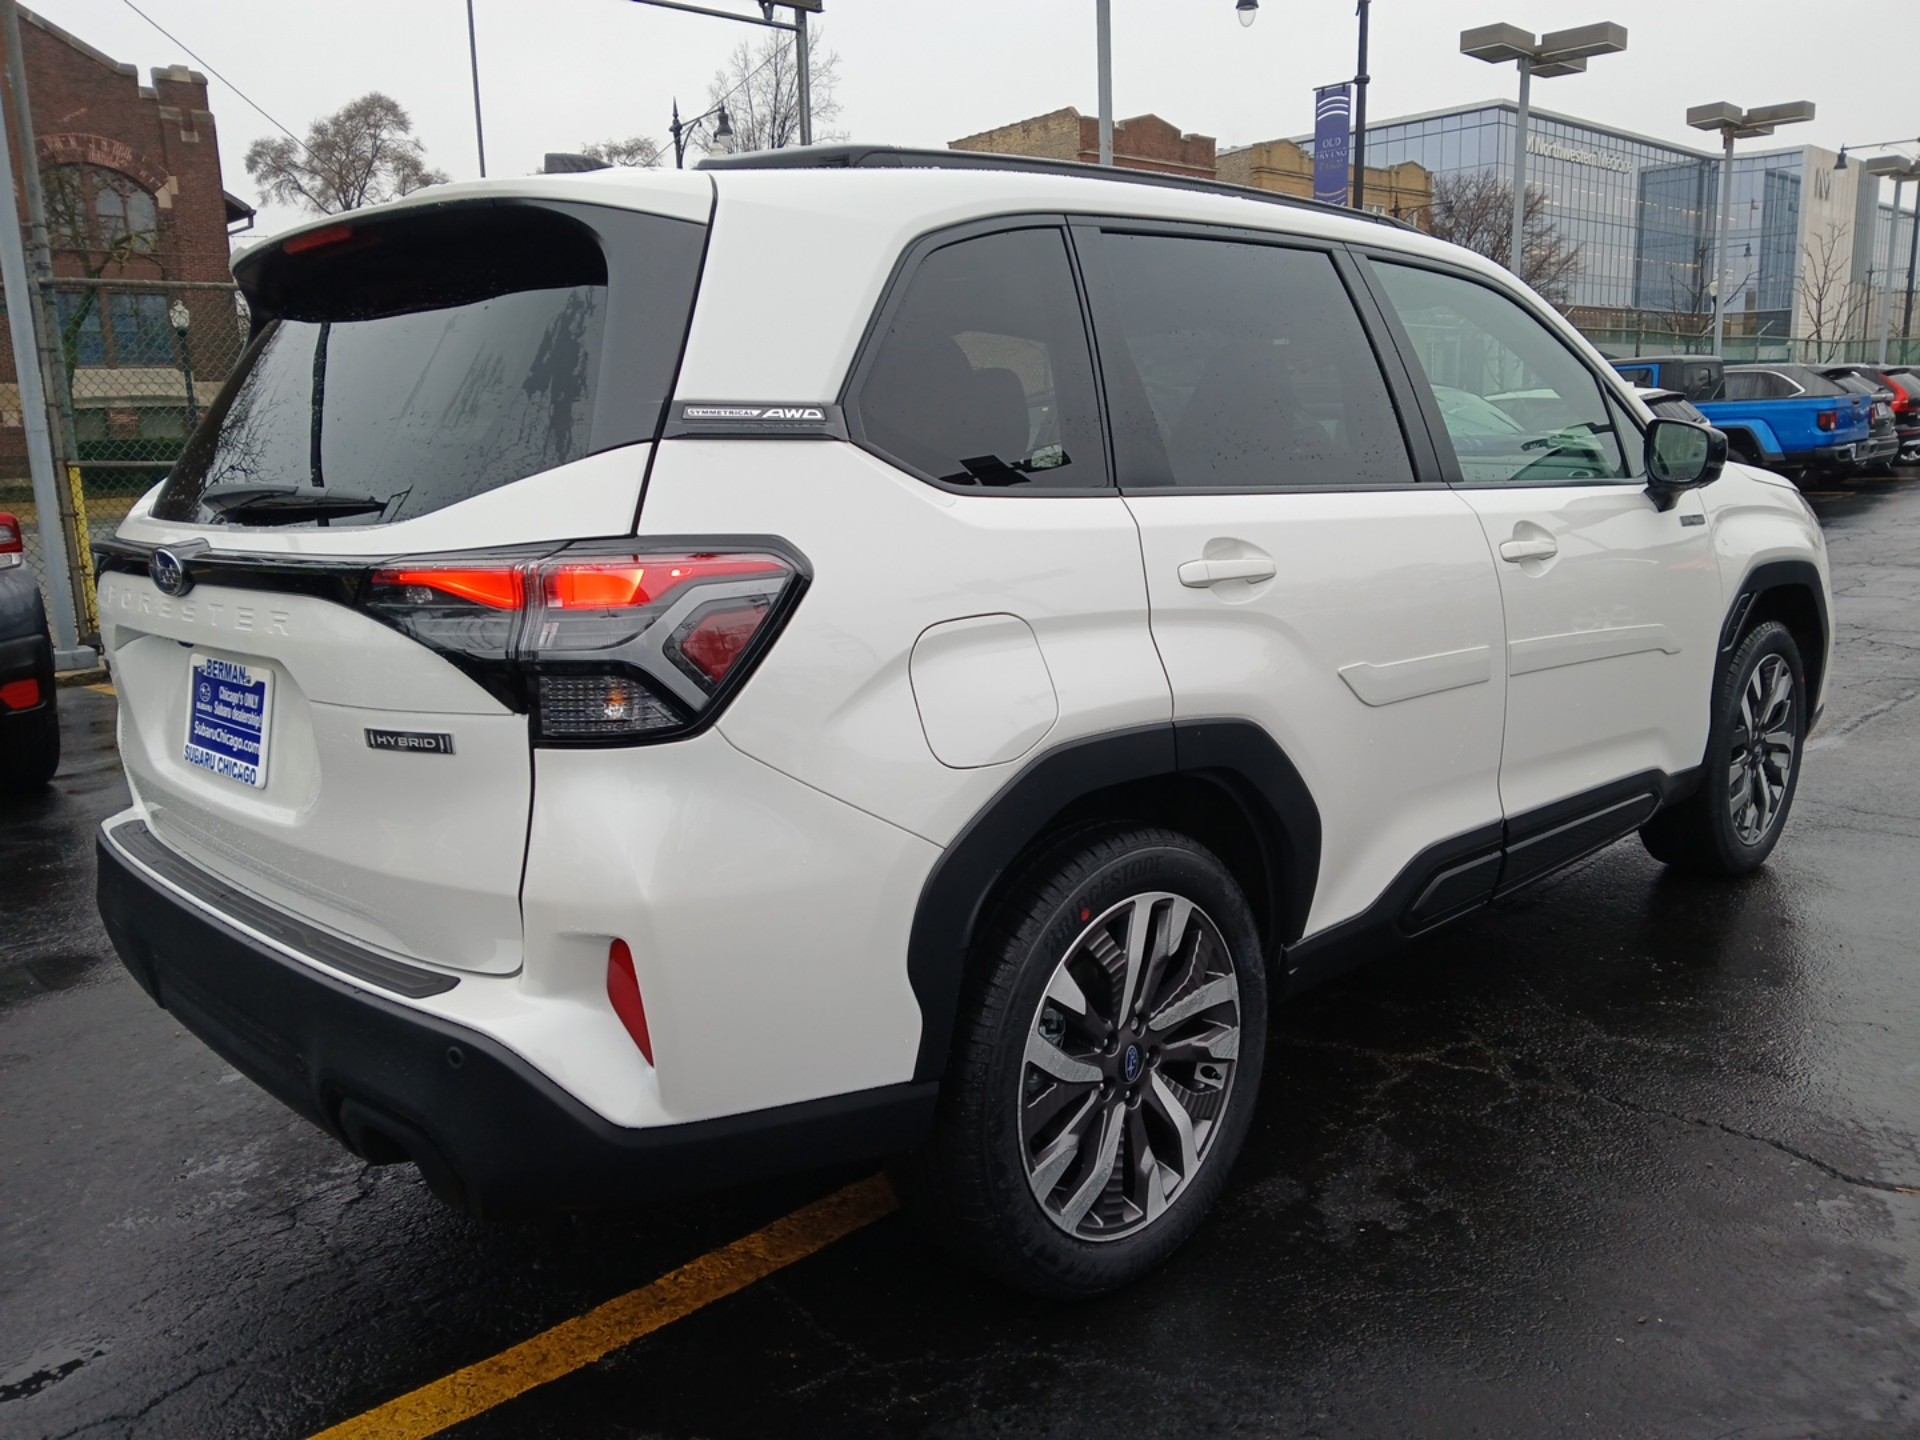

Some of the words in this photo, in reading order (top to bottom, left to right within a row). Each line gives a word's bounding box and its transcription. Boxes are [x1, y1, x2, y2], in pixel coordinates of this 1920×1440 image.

[1322, 137, 1342, 148] OLD
[689, 408, 755, 417] SYMMETRICAL
[762, 408, 823, 419] AWD
[101, 585, 289, 636] FORESTER
[206, 659, 247, 684] BERMAN
[194, 720, 261, 754] SubaruChicago.com
[376, 735, 437, 748] HYBRID
[184, 744, 216, 770] SUBARU
[216, 757, 257, 785] CHICAGO
